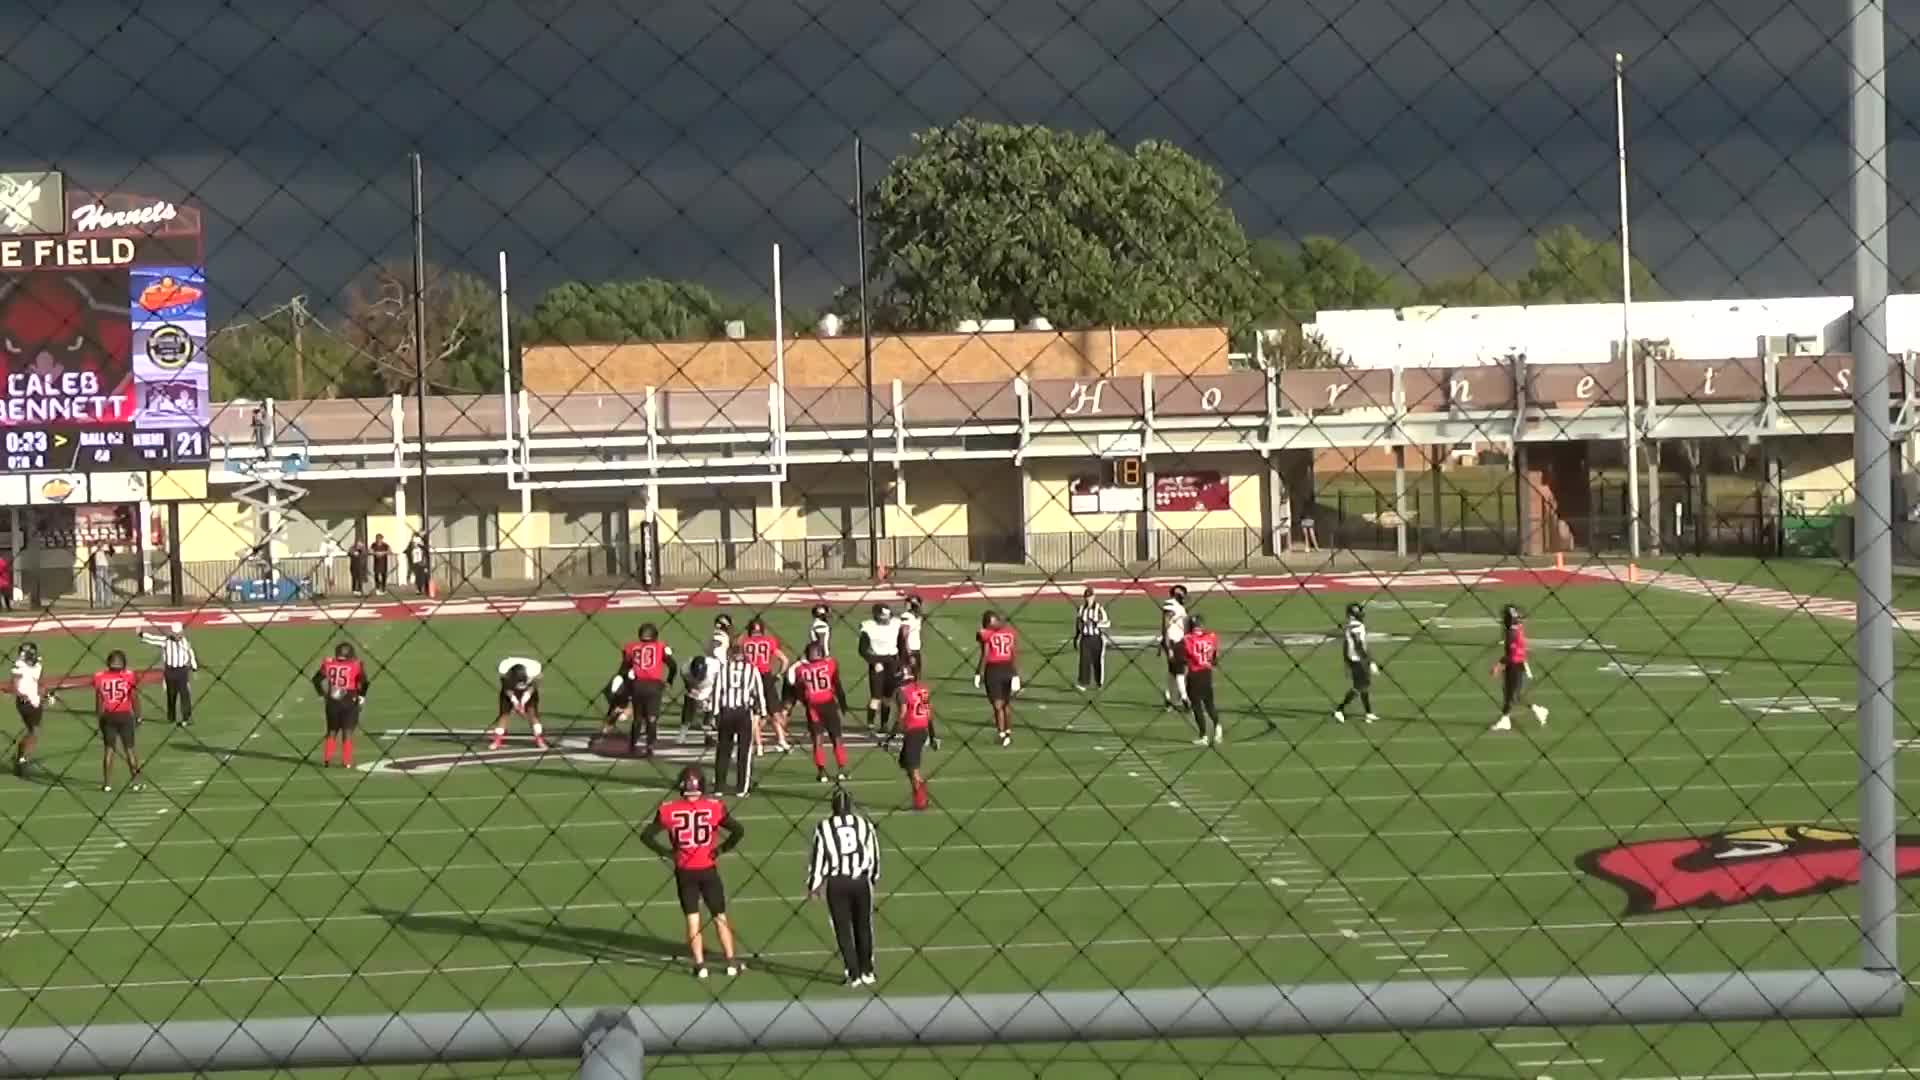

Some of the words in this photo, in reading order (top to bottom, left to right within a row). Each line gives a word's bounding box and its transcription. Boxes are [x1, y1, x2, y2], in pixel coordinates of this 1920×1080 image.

[34, 238, 136, 266] FIELD
[7, 371, 99, 397] CALEB
[177, 432, 202, 456] 21
[743, 641, 770, 665] 99
[801, 664, 832, 694] 46
[671, 808, 713, 848] 26
[837, 826, 858, 855] B
